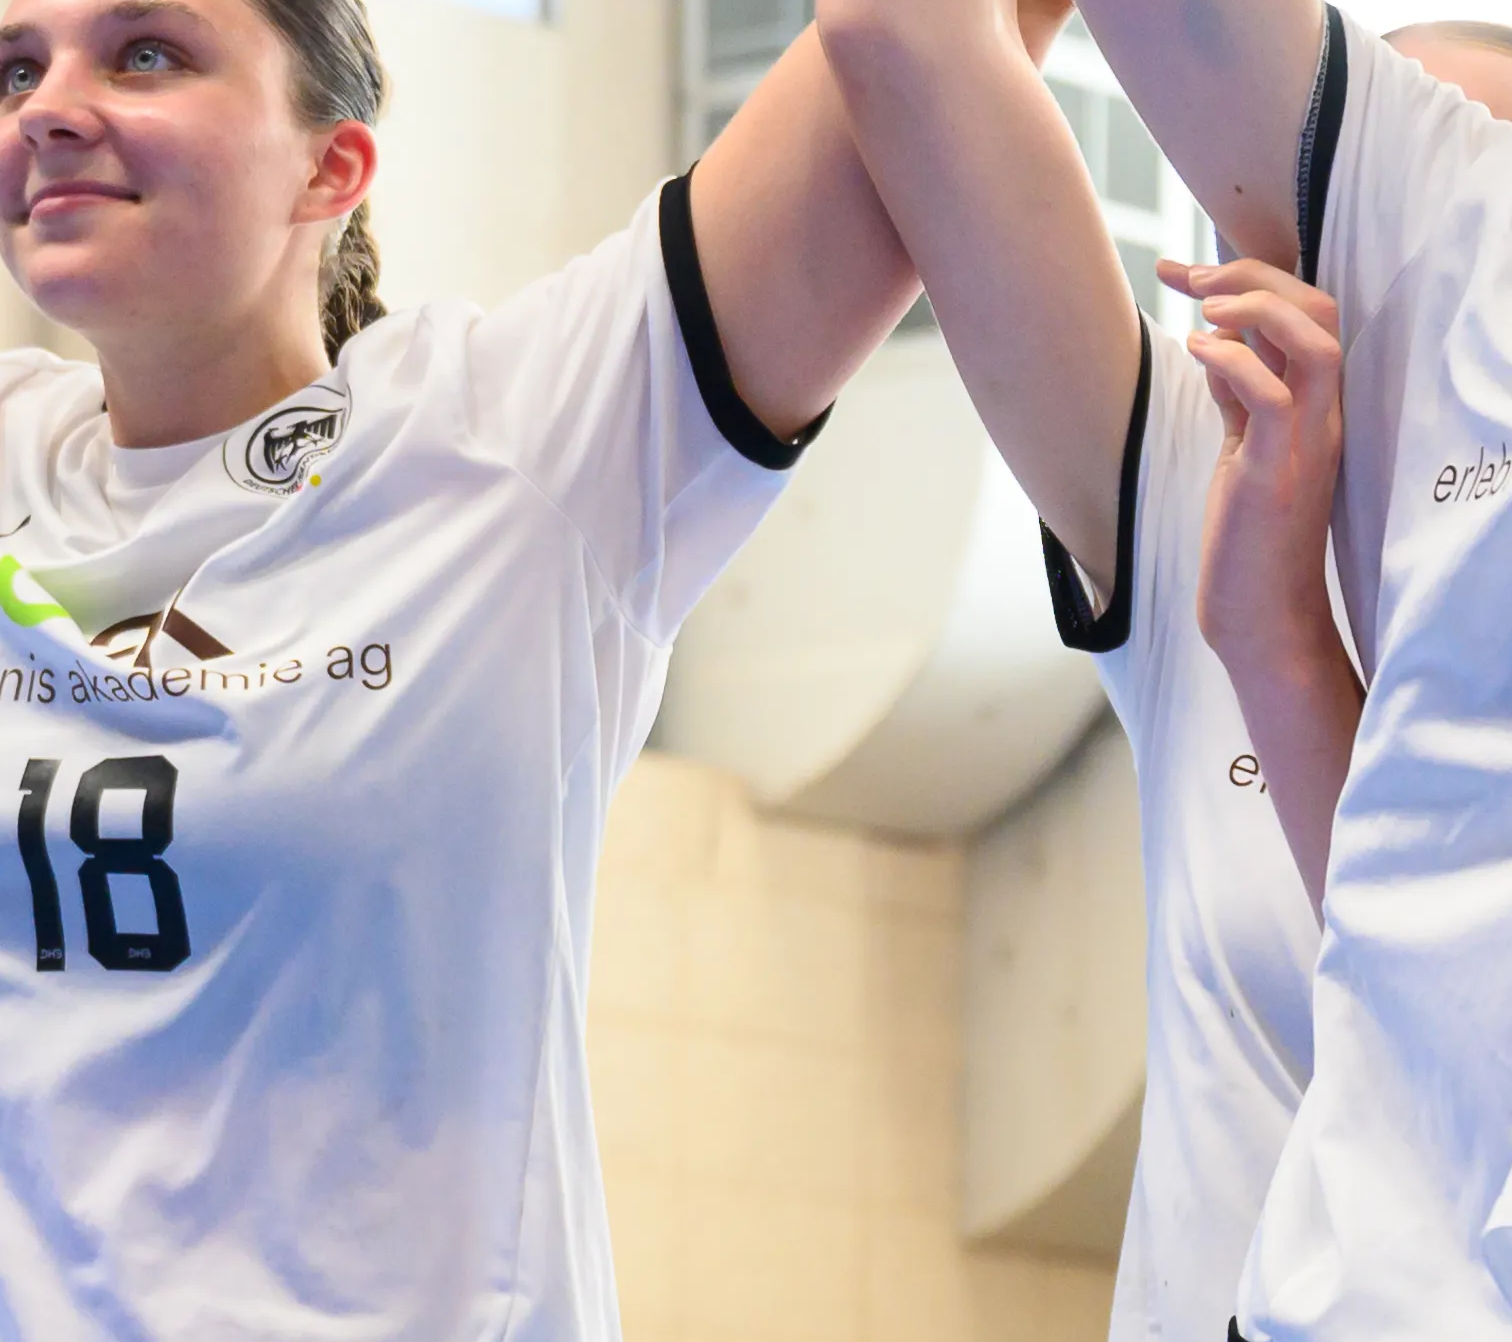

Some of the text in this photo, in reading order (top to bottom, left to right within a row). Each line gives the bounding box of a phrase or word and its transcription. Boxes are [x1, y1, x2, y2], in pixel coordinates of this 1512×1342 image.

[70, 655, 304, 705] akademie
[326, 640, 393, 690] ag
[17, 754, 192, 973] 18
